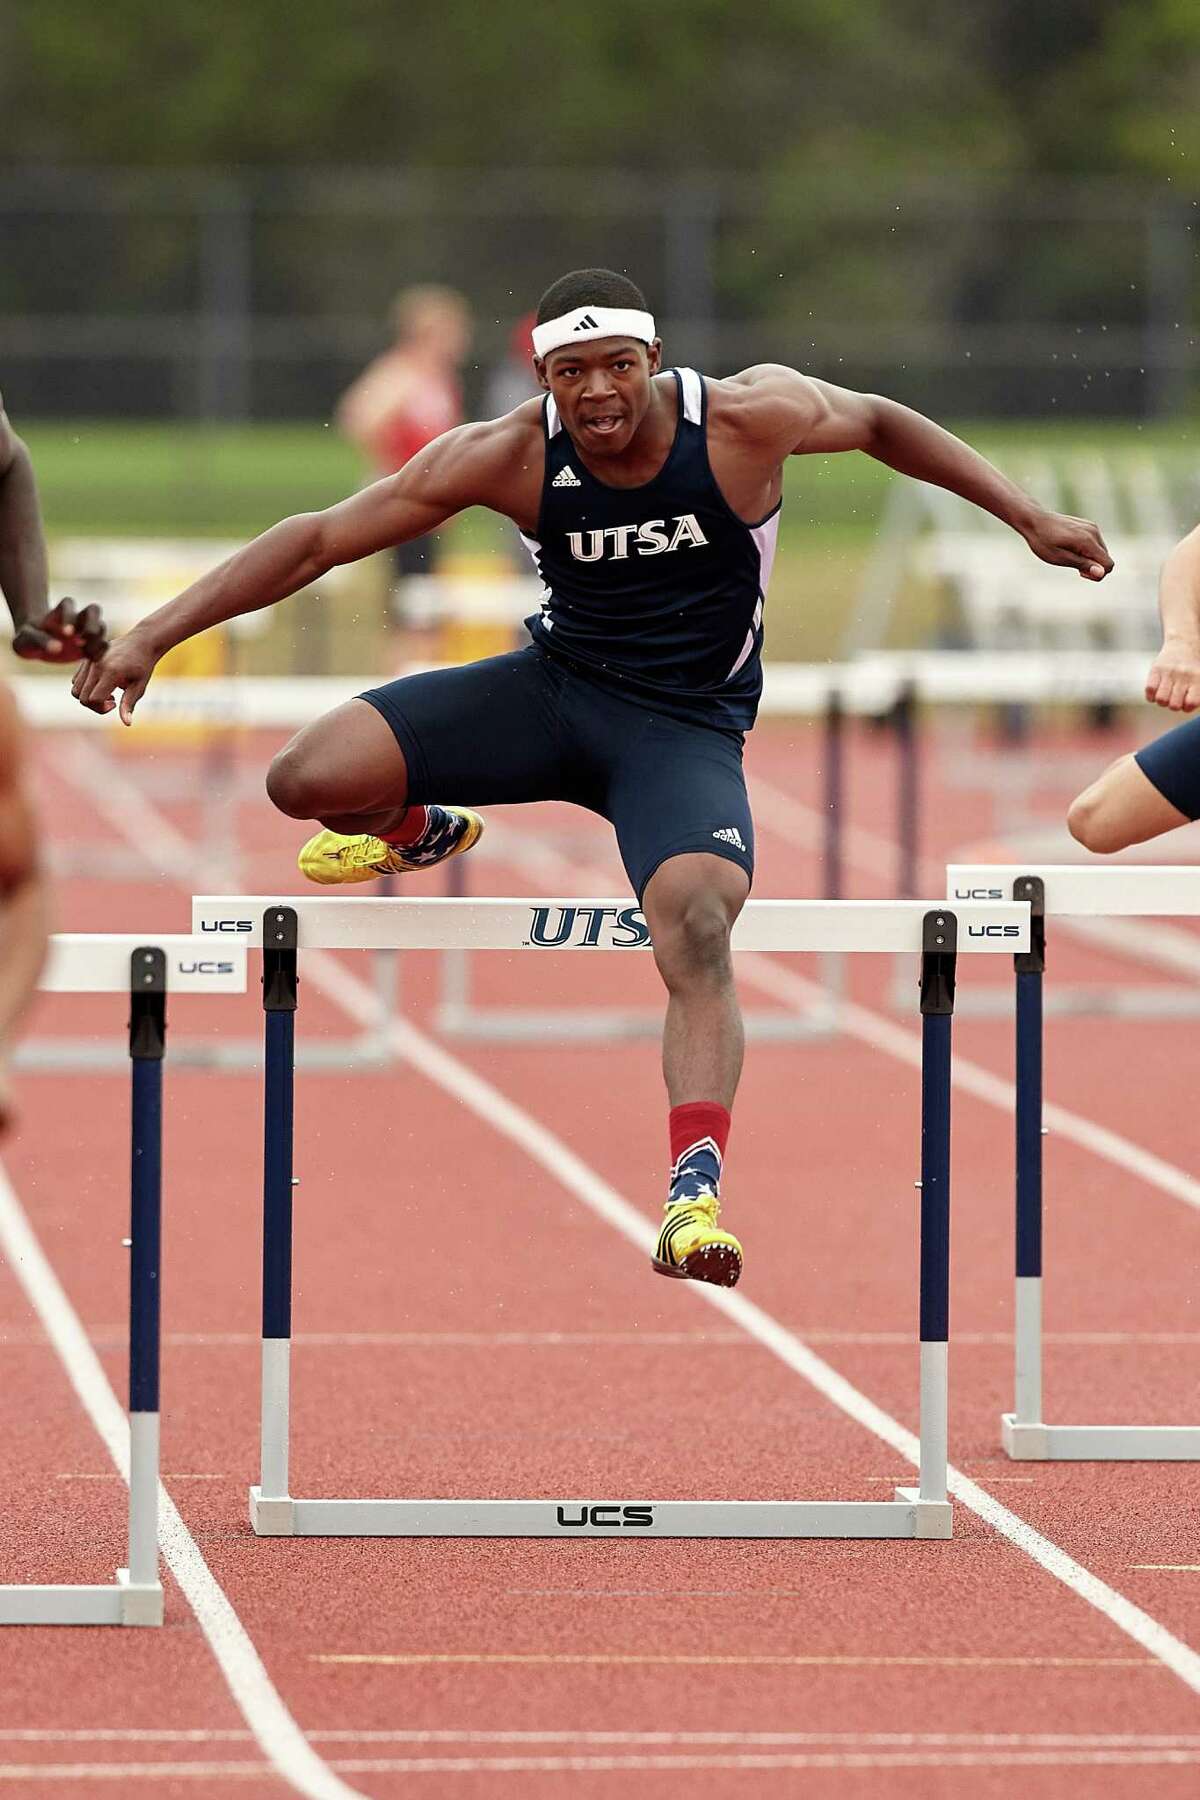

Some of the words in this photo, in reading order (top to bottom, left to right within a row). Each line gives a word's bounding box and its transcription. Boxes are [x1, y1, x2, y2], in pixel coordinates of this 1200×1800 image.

[552, 479, 582, 487] adidas
[565, 513, 709, 562] UTSA
[712, 829, 747, 852] adidas
[955, 889, 1003, 899] UCS
[201, 920, 253, 932] UCS
[529, 907, 653, 947] UTS
[968, 925, 1020, 937] UCS
[179, 962, 234, 973] UCS
[557, 1506, 653, 1527] UCS
